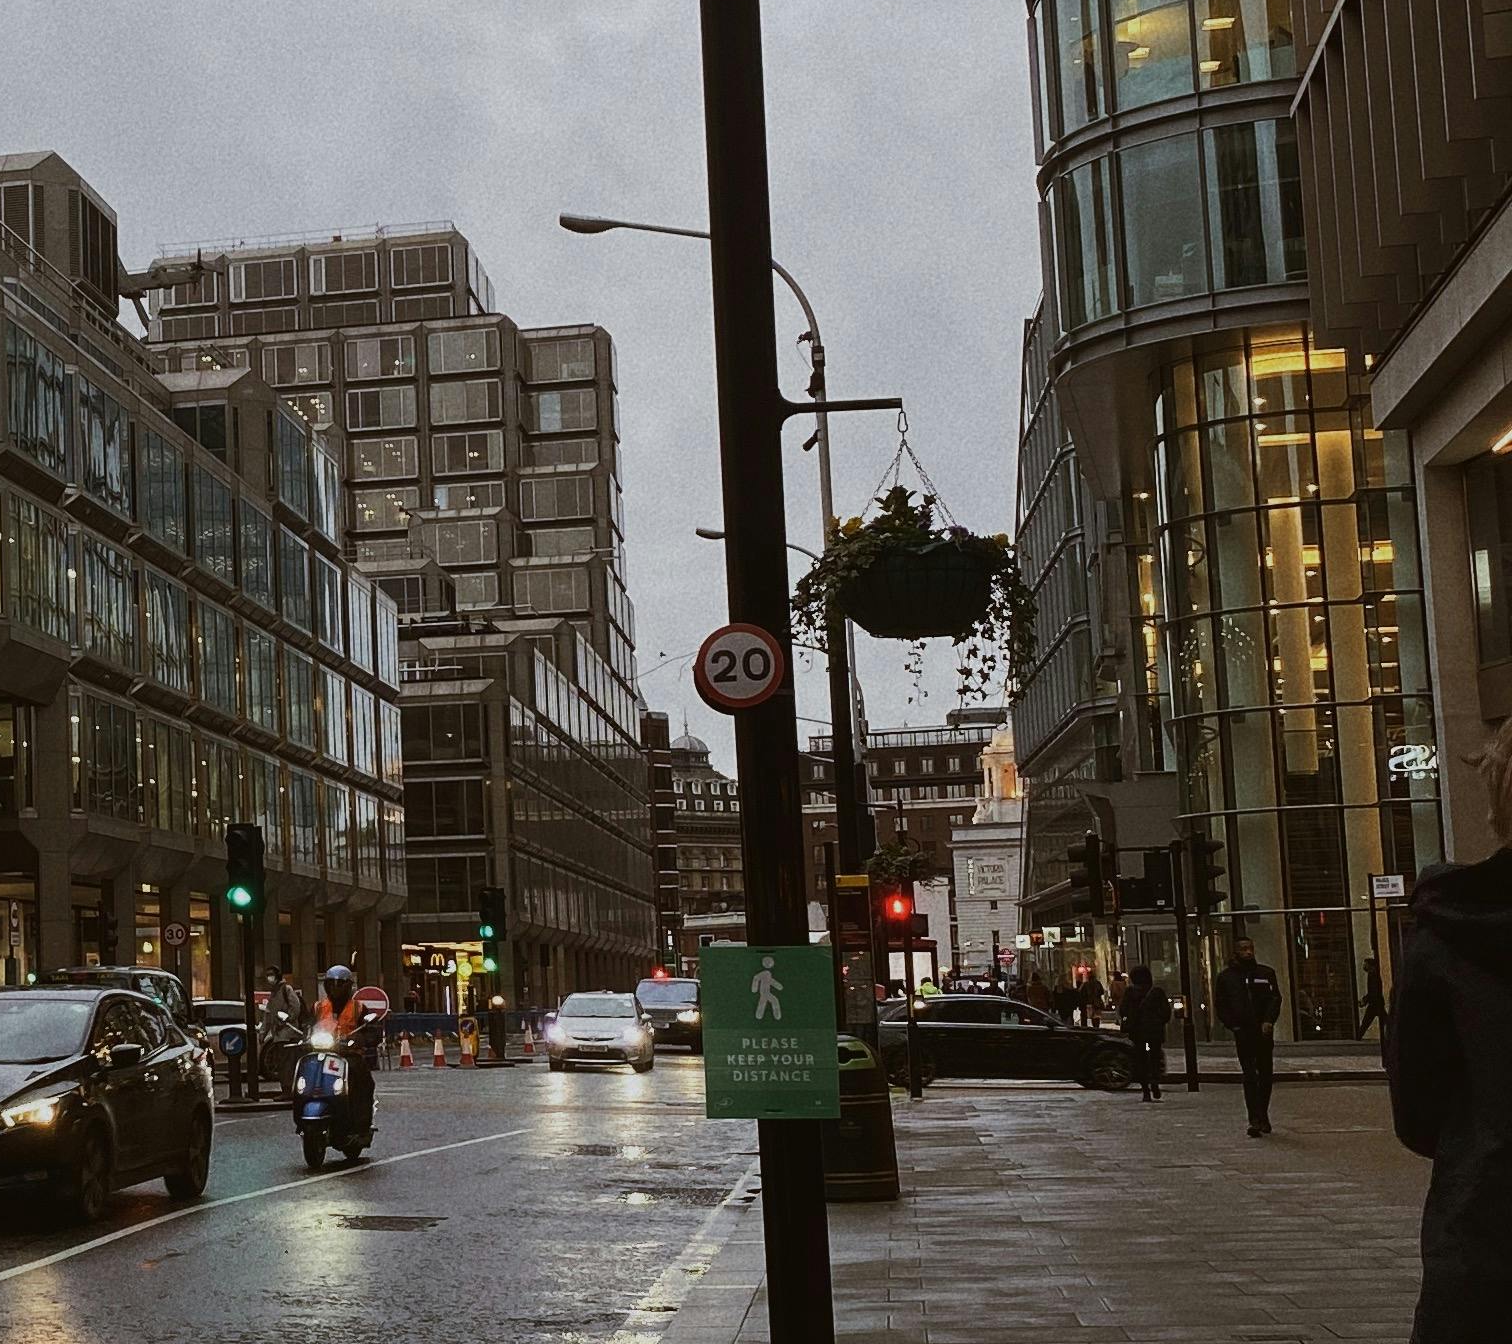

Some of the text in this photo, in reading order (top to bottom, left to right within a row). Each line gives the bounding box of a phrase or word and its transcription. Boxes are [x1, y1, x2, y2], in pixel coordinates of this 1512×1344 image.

[711, 647, 771, 684] 20
[978, 876, 1004, 885] PALACE
[166, 928, 184, 940] 30
[742, 1038, 799, 1049] PLEASE
[727, 1054, 814, 1065] KEEP YOUR
[733, 1070, 811, 1082] DISTANCE
